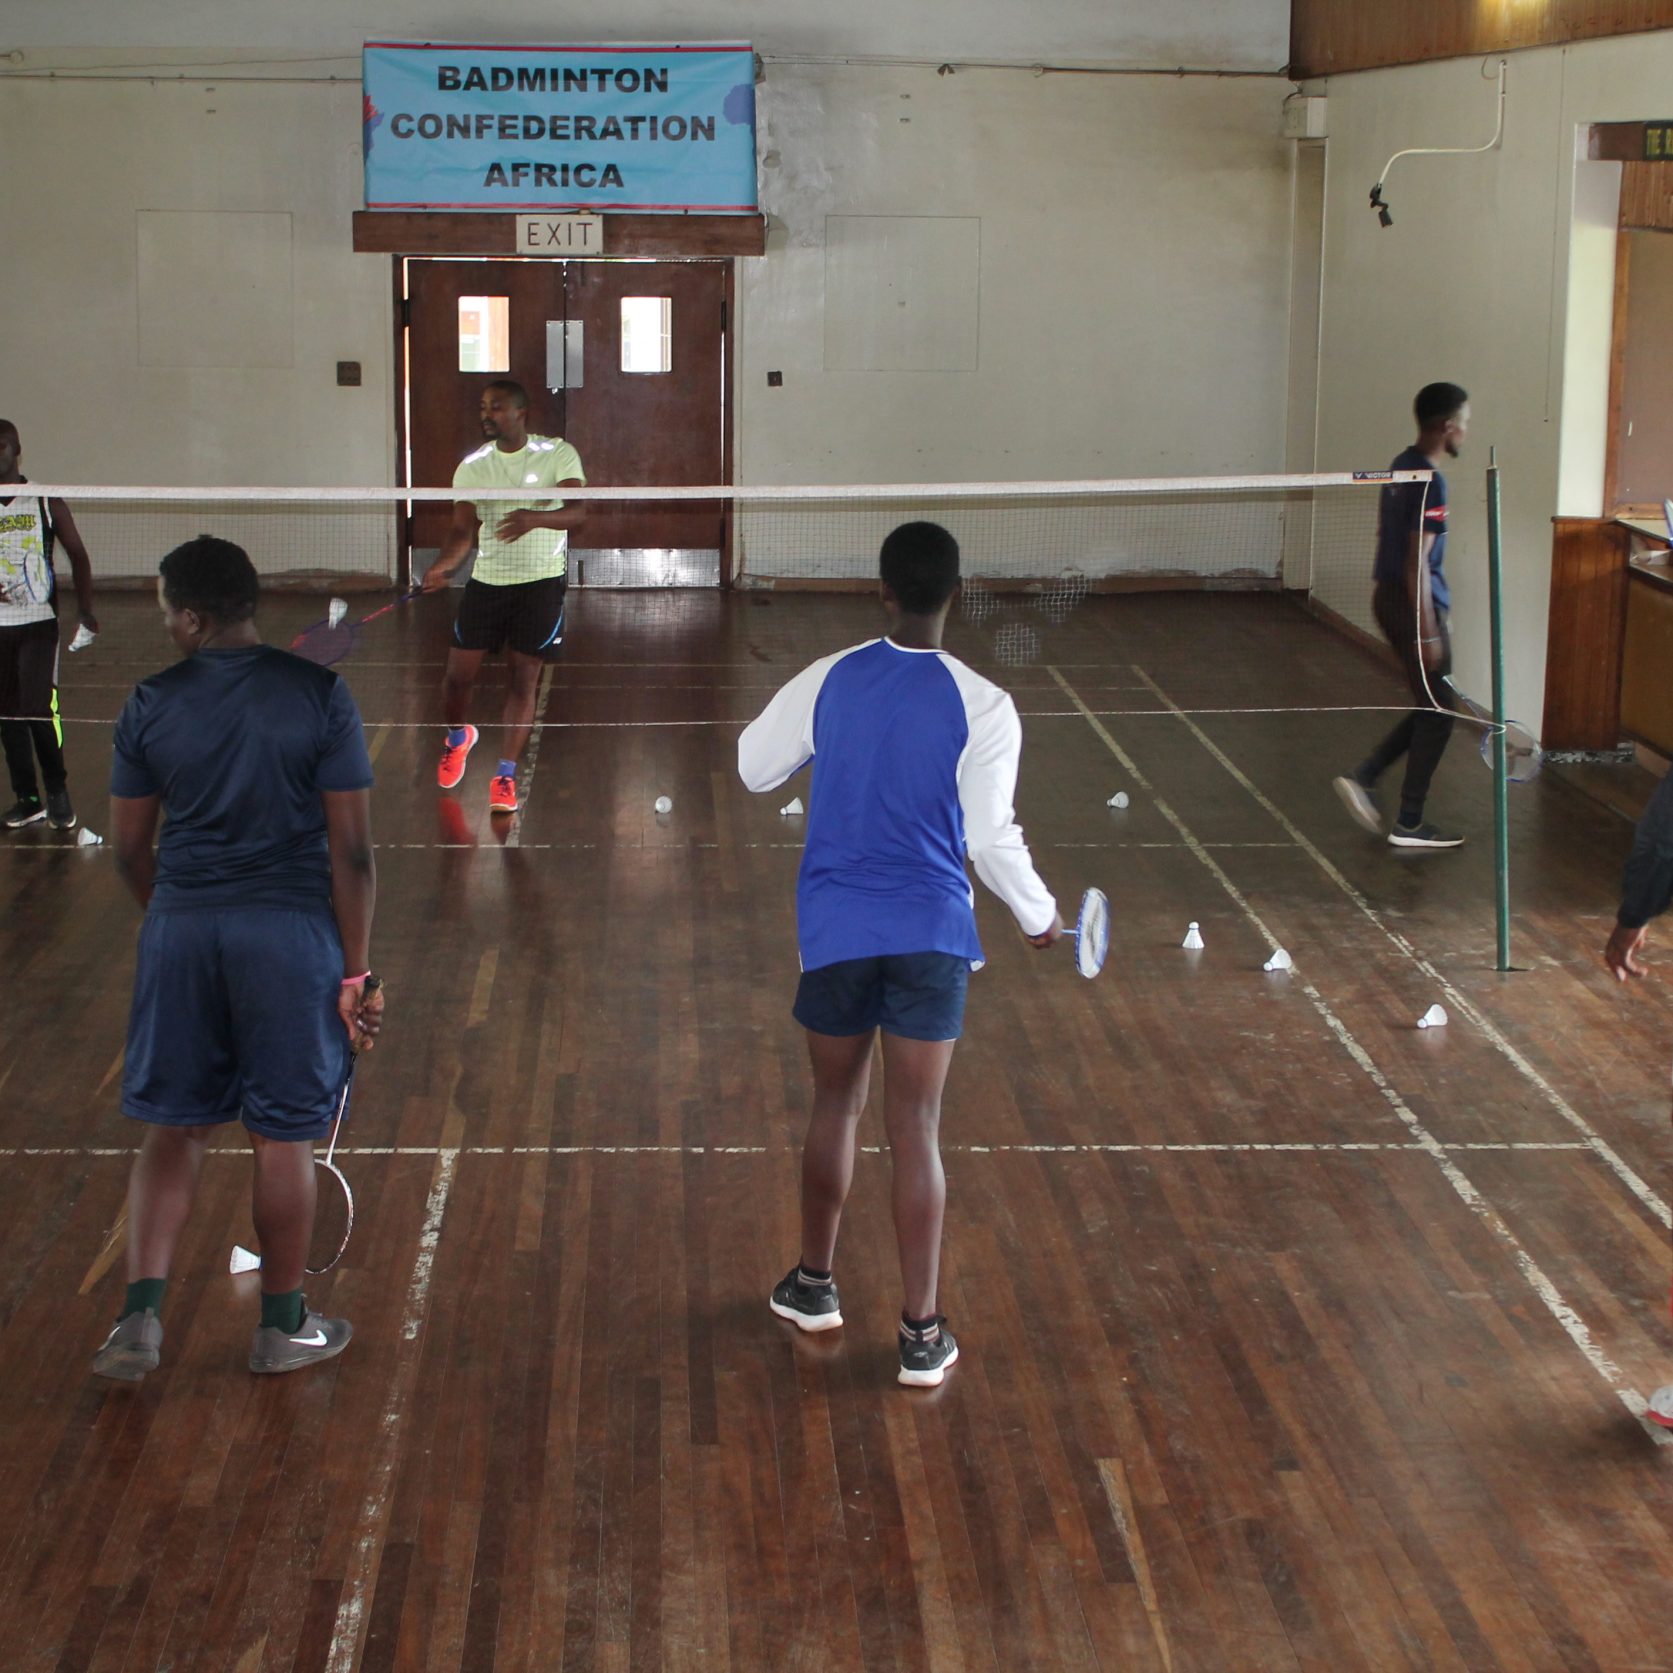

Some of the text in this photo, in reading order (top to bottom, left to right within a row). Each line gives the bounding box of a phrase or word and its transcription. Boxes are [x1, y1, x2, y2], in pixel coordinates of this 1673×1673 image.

[437, 66, 668, 92] BADMINTON
[390, 113, 715, 141] CONFEDERATION
[483, 163, 625, 188] AFRICA
[527, 222, 593, 247] EXIT
